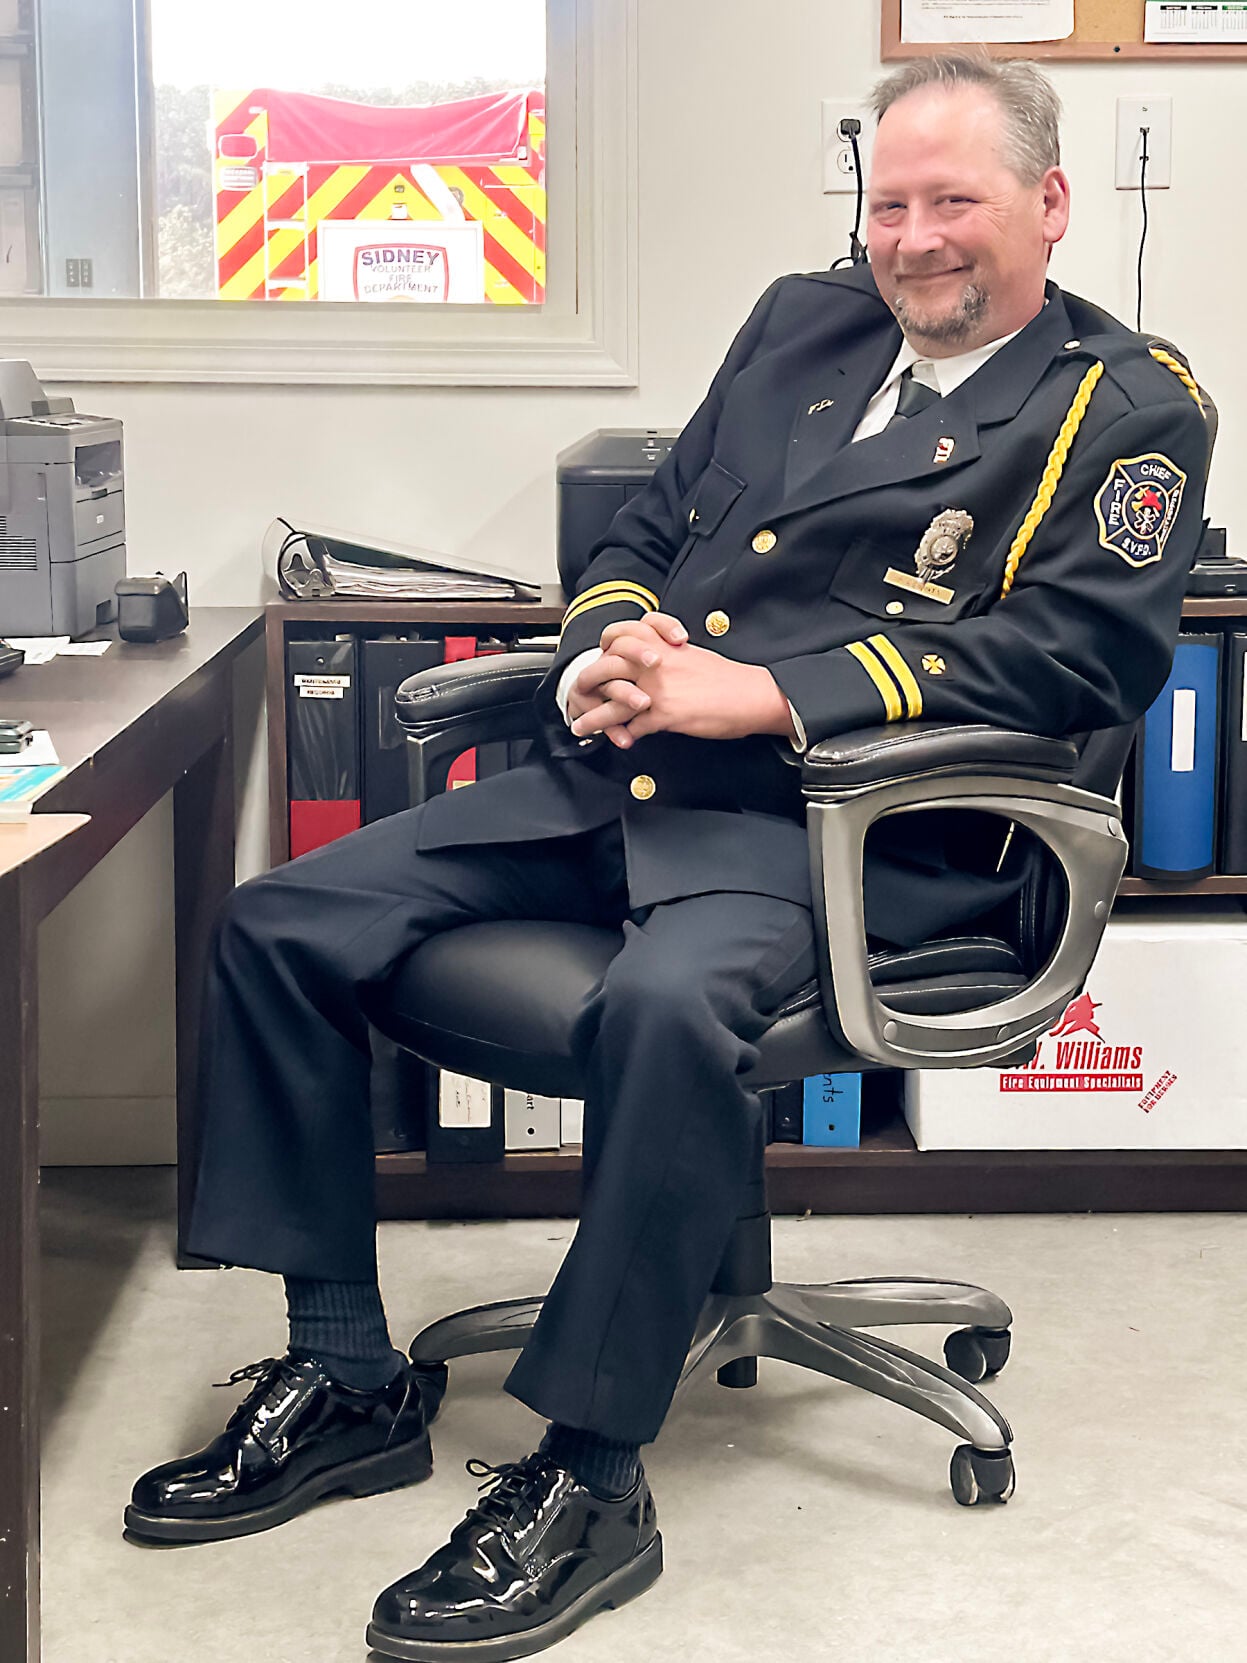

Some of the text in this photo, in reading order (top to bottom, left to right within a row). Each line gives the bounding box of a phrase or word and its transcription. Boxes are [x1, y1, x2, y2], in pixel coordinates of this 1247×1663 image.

[361, 249, 440, 266] SIDNEY
[371, 264, 431, 273] VOLUNTEER
[389, 273, 412, 284] FIRE
[364, 282, 438, 294] DEPARTMENT
[1140, 463, 1172, 481] CHIEF
[1108, 478, 1126, 526] FIRE
[1055, 1041, 1143, 1070] Williams
[1002, 1076, 1142, 1090] Fire Equipment Specialists
